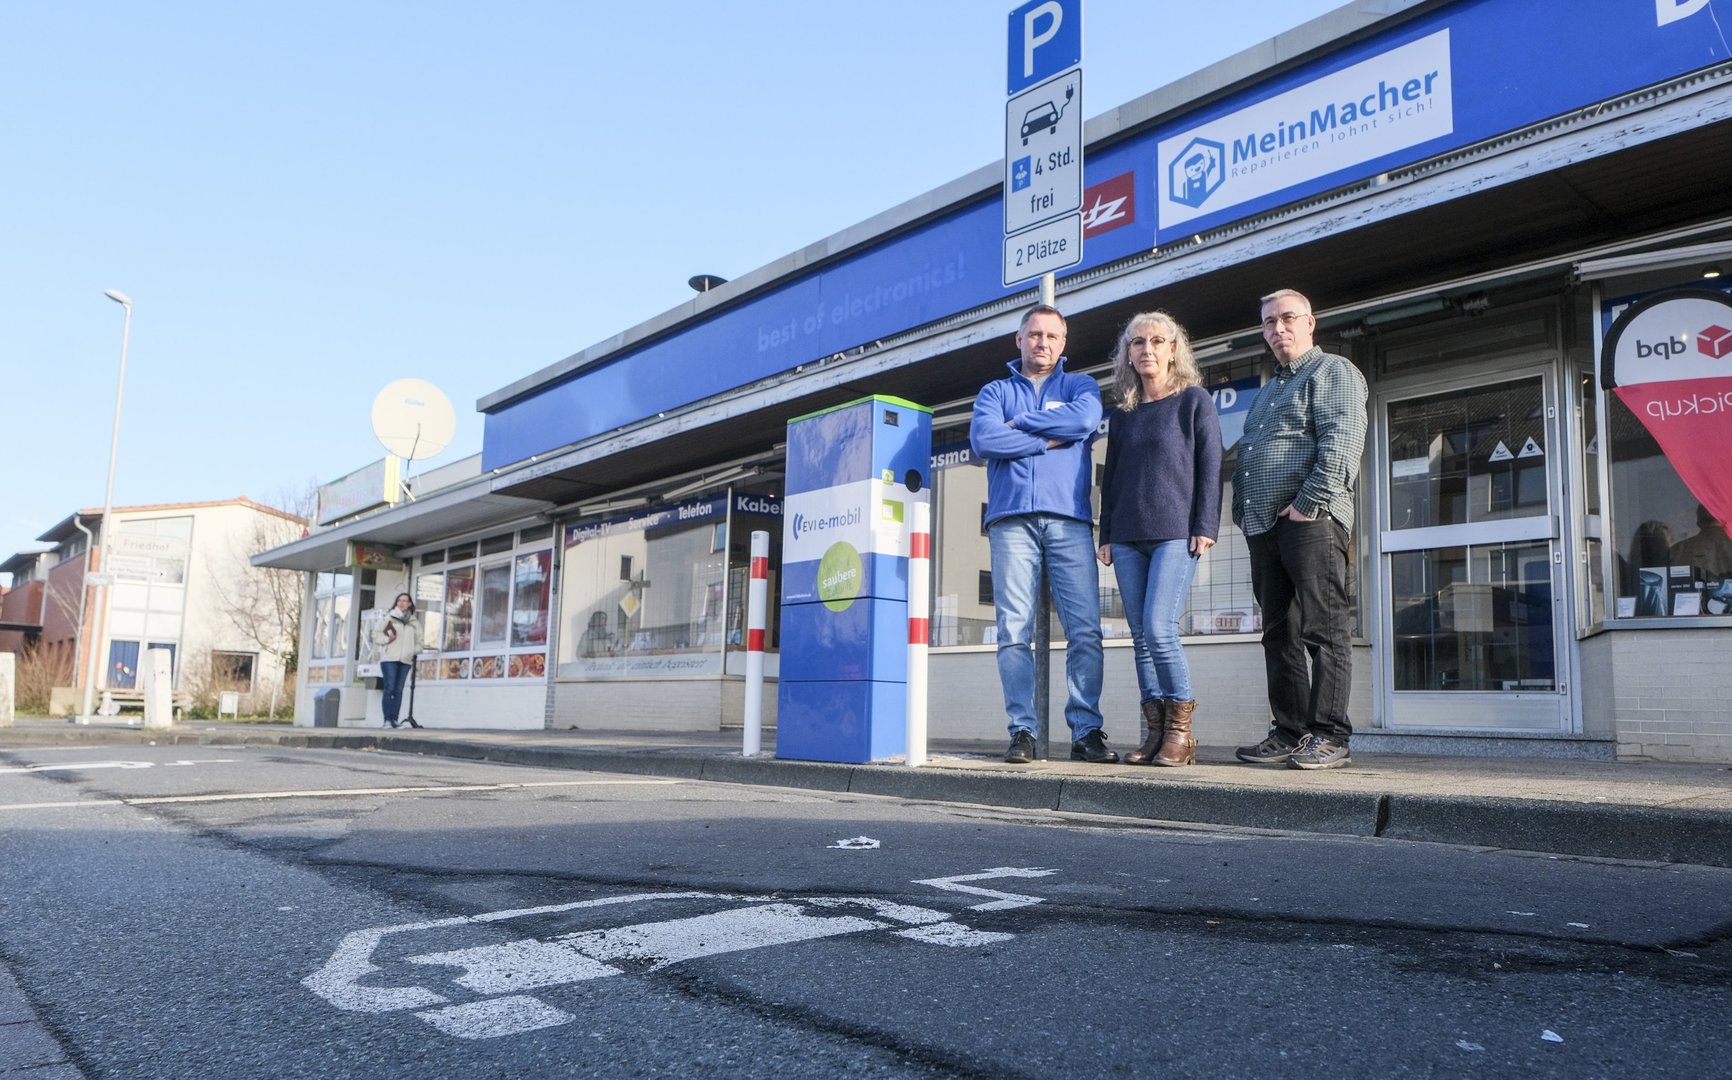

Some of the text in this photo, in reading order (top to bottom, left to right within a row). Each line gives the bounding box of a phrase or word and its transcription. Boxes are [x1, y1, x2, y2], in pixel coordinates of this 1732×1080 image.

[1024, 0, 1063, 78] P
[1232, 70, 1438, 165] MeinMacher
[1231, 97, 1433, 178] Reparieren lohnt sich!
[1035, 146, 1074, 176] 4 Std.
[1030, 187, 1054, 213] frei
[1082, 194, 1127, 230] tz
[1016, 238, 1067, 267] 2 Plätze
[757, 251, 965, 352] best of electronics!
[930, 448, 970, 468] asma
[737, 496, 784, 516] Kabel
[818, 506, 861, 530] e-mobil
[572, 502, 712, 542] Digital-TV Service Telefon
[822, 567, 857, 589] saubere
